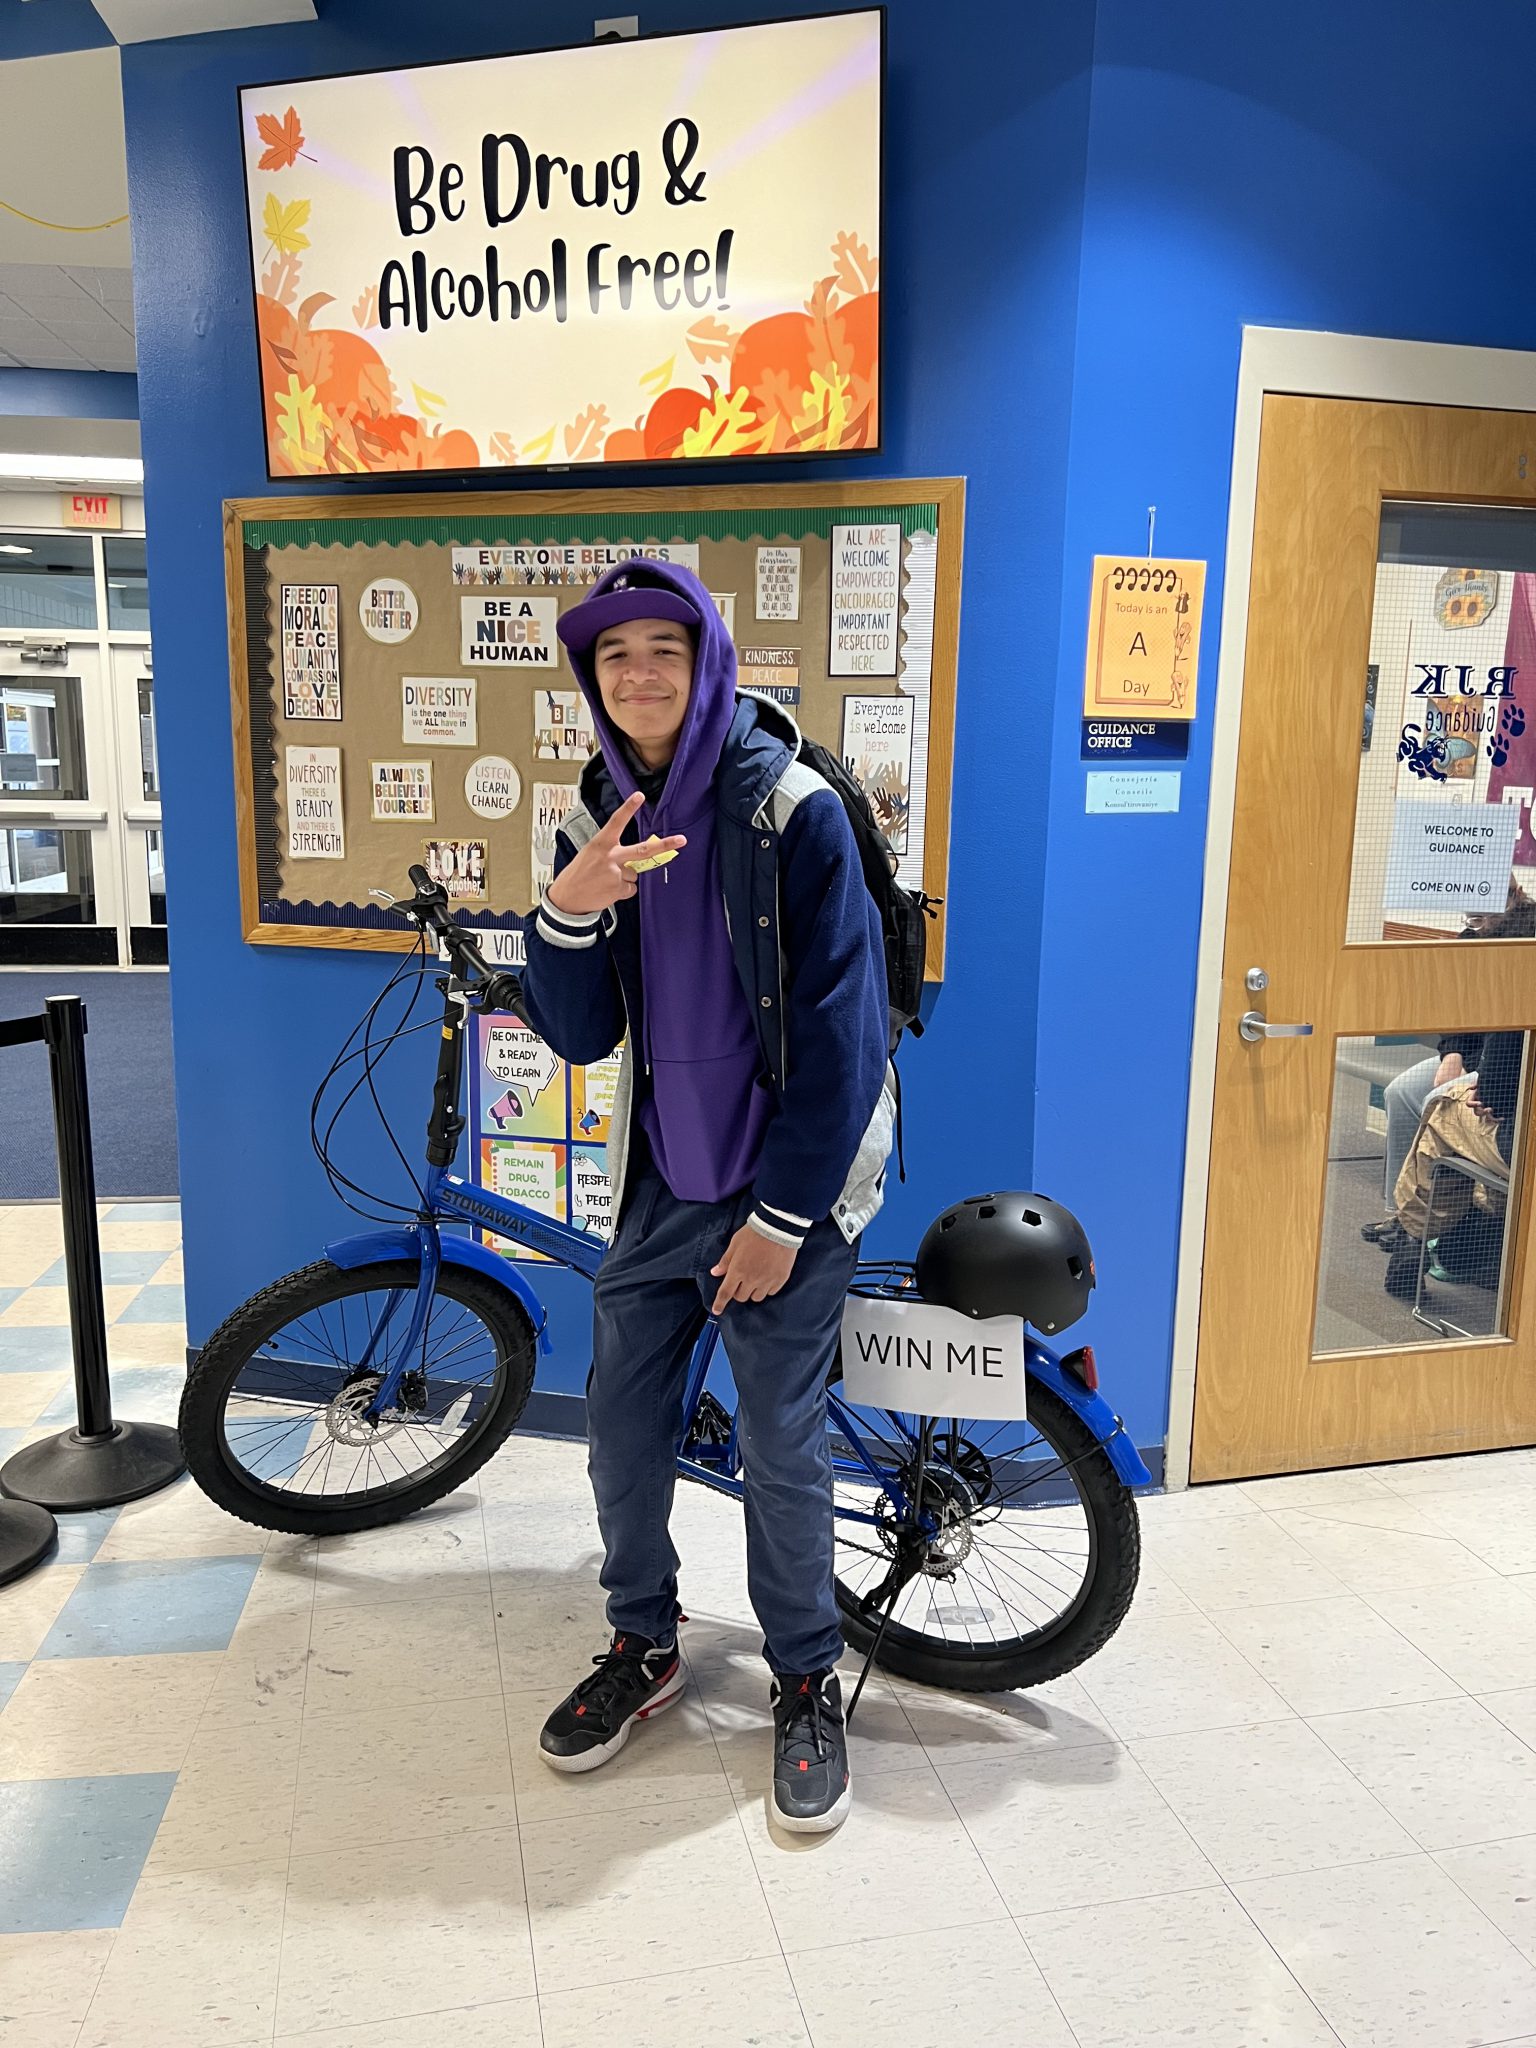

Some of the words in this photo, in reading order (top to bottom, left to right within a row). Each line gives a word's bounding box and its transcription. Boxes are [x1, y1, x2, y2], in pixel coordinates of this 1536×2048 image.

[393, 146, 465, 238] Be
[481, 133, 640, 228] Drug
[661, 118, 707, 206] &
[378, 238, 567, 333] Alcohol
[588, 229, 735, 315] Free!
[846, 529, 863, 546] ALL
[868, 528, 887, 546] ARE
[479, 549, 575, 566] EVERYONE
[842, 550, 890, 567] WELCOME
[836, 571, 895, 588] EMPOWERED
[284, 588, 336, 604] FREEDOM
[371, 589, 405, 609] BETTER
[834, 592, 896, 609] ENCOURAGED
[484, 601, 512, 617] BE
[518, 602, 533, 617] A
[1115, 602, 1144, 616] Today
[1146, 603, 1153, 615] is
[1154, 605, 1168, 615] an
[284, 606, 336, 631] MORALS
[365, 609, 411, 630] TOGETHER
[838, 613, 891, 630] IMPORTANT
[476, 620, 541, 644] NICE
[285, 632, 336, 648] PEACE
[838, 634, 890, 651] RESPECTED
[1128, 631, 1148, 656] A
[285, 649, 337, 669] HUMANITY
[470, 645, 549, 661] HUMAN
[745, 650, 796, 665] KINDNESS.
[851, 655, 875, 671] HERE
[286, 670, 338, 683] COMPASSION
[288, 683, 338, 698] LOVE
[745, 687, 795, 702] ALITY.
[1122, 680, 1150, 697] Day
[405, 686, 472, 707] DIVERSITY
[288, 698, 339, 717] DECENCY
[411, 708, 418, 717] is
[420, 709, 431, 717] the
[448, 710, 467, 720] thing
[553, 707, 577, 722] BE
[854, 701, 904, 719] Everyone
[425, 718, 438, 726] ALL
[440, 719, 458, 727] have
[459, 719, 467, 727] in
[849, 720, 861, 734] is
[864, 720, 906, 734] welcome
[1088, 723, 1156, 735] GUIDANCE
[423, 728, 456, 736] common.
[540, 731, 588, 746] KIND
[864, 738, 889, 752] here
[1087, 736, 1132, 748] OFFICE
[309, 753, 317, 762] IN
[289, 765, 338, 784] DIVERSITY
[379, 768, 425, 783] ALWAYS
[475, 766, 511, 780] LISTEN
[301, 788, 320, 797] THERE
[321, 788, 326, 797] IS
[375, 784, 416, 798] BELIEVE
[418, 784, 430, 798] IN
[476, 780, 509, 795] LEARN
[471, 795, 513, 809] CHANGE
[541, 787, 575, 807] SMAL
[296, 799, 333, 818] BEAUTY
[376, 799, 431, 814] YOURSELF
[296, 822, 310, 831] AND
[310, 822, 330, 832] THERE
[330, 823, 336, 832] IS
[1424, 825, 1478, 837] WELCOME
[1480, 827, 1494, 837] TO
[292, 833, 342, 852] STRENGTH
[1429, 843, 1485, 854] GUIDANCE
[429, 849, 481, 877] LOVE
[1411, 881, 1443, 892] COME
[1445, 882, 1461, 893] ON
[1463, 883, 1475, 893] IN
[494, 934, 528, 961] VOIC
[492, 1031, 504, 1041] BE
[505, 1032, 518, 1041] ON
[520, 1033, 543, 1043] TIME
[499, 1048, 506, 1059] &
[507, 1050, 538, 1060] READY
[497, 1066, 510, 1077] TO
[511, 1067, 541, 1078] LEARN
[503, 1157, 544, 1169] REMAIN
[508, 1172, 540, 1185] DRUG,
[577, 1174, 611, 1188] RESPE
[498, 1187, 550, 1199] TOBACCO
[441, 1188, 529, 1235] STOWAWAY
[855, 1331, 932, 1371] WIN
[947, 1342, 1004, 1379] ME
